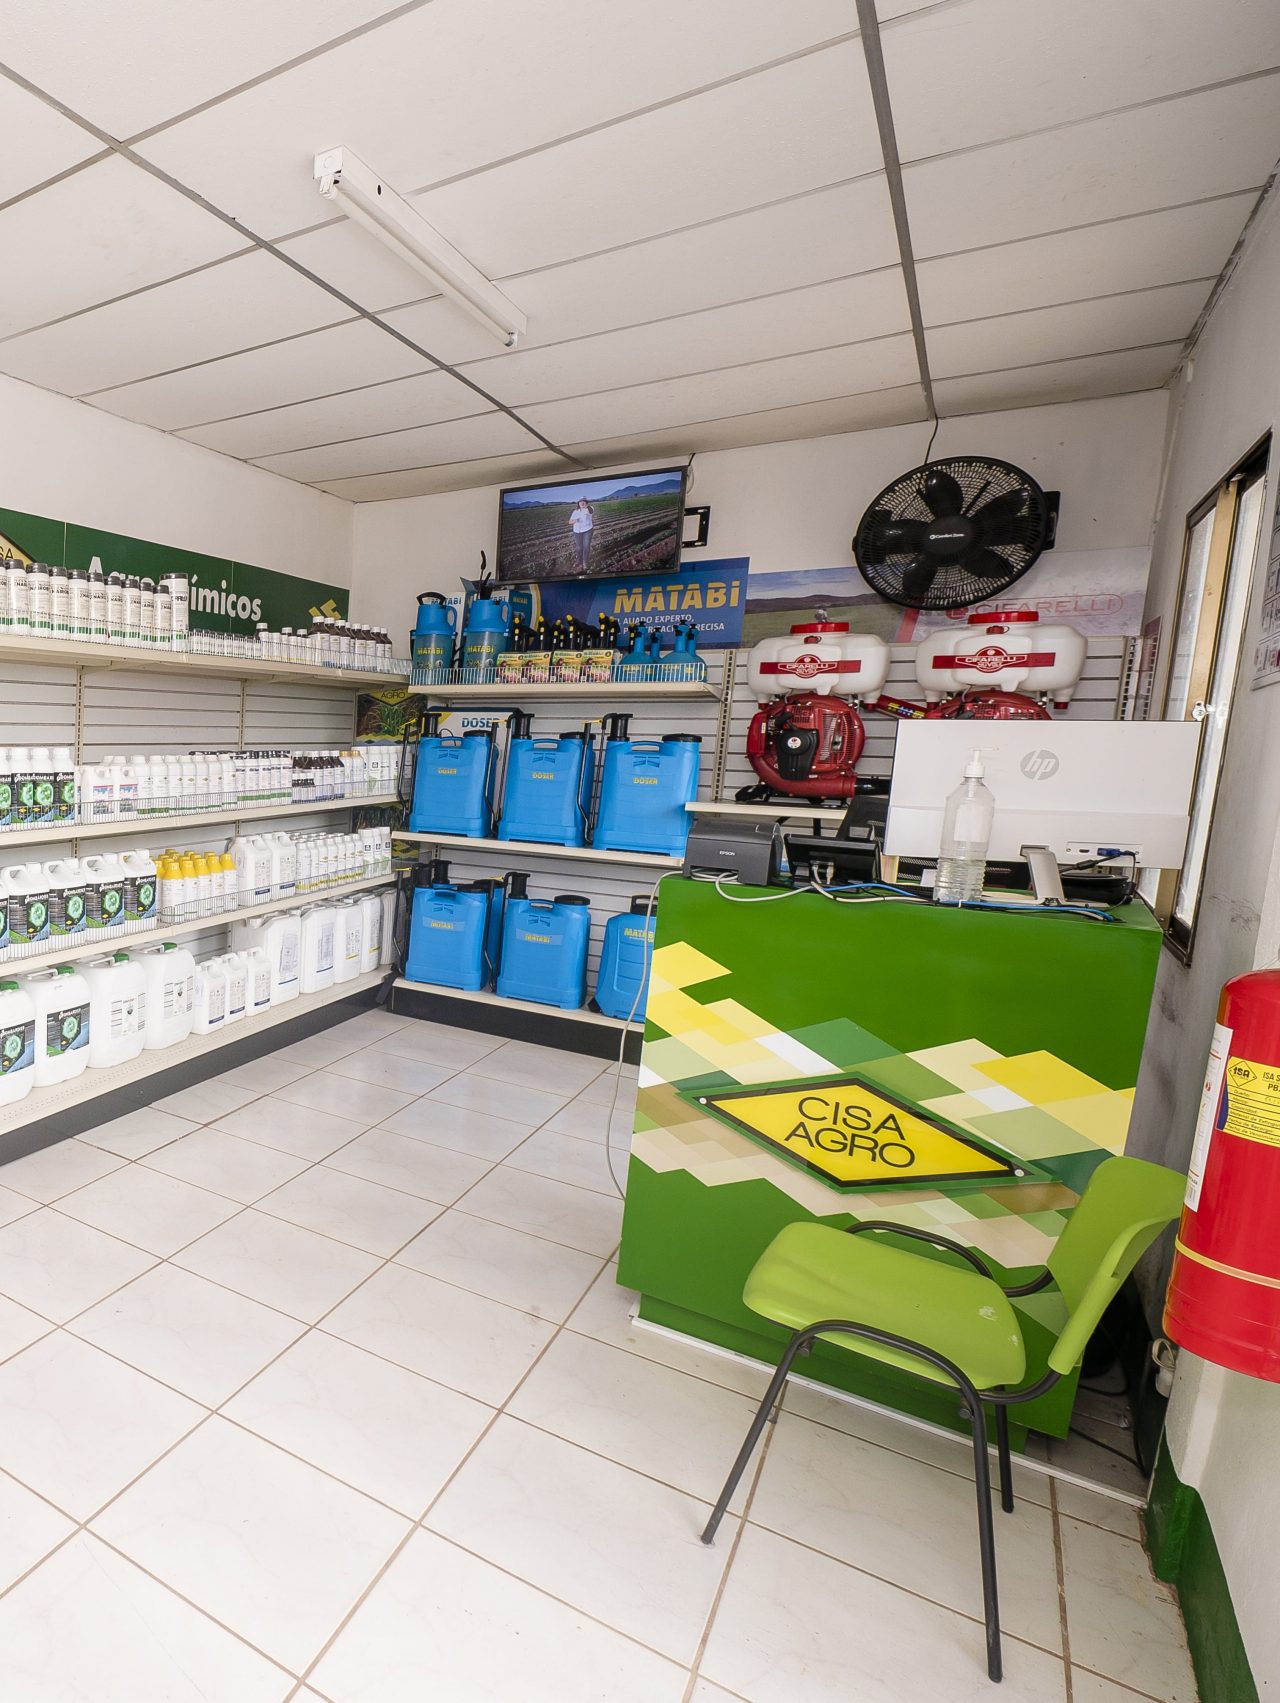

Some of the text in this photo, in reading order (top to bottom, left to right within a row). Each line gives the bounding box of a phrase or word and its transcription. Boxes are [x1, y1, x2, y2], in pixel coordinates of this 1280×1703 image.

[614, 581, 740, 613] MATABI
[690, 623, 725, 633] RECISA
[624, 927, 654, 940] MATAB
[798, 1096, 906, 1141] CISA
[784, 1121, 916, 1168] AGRO
